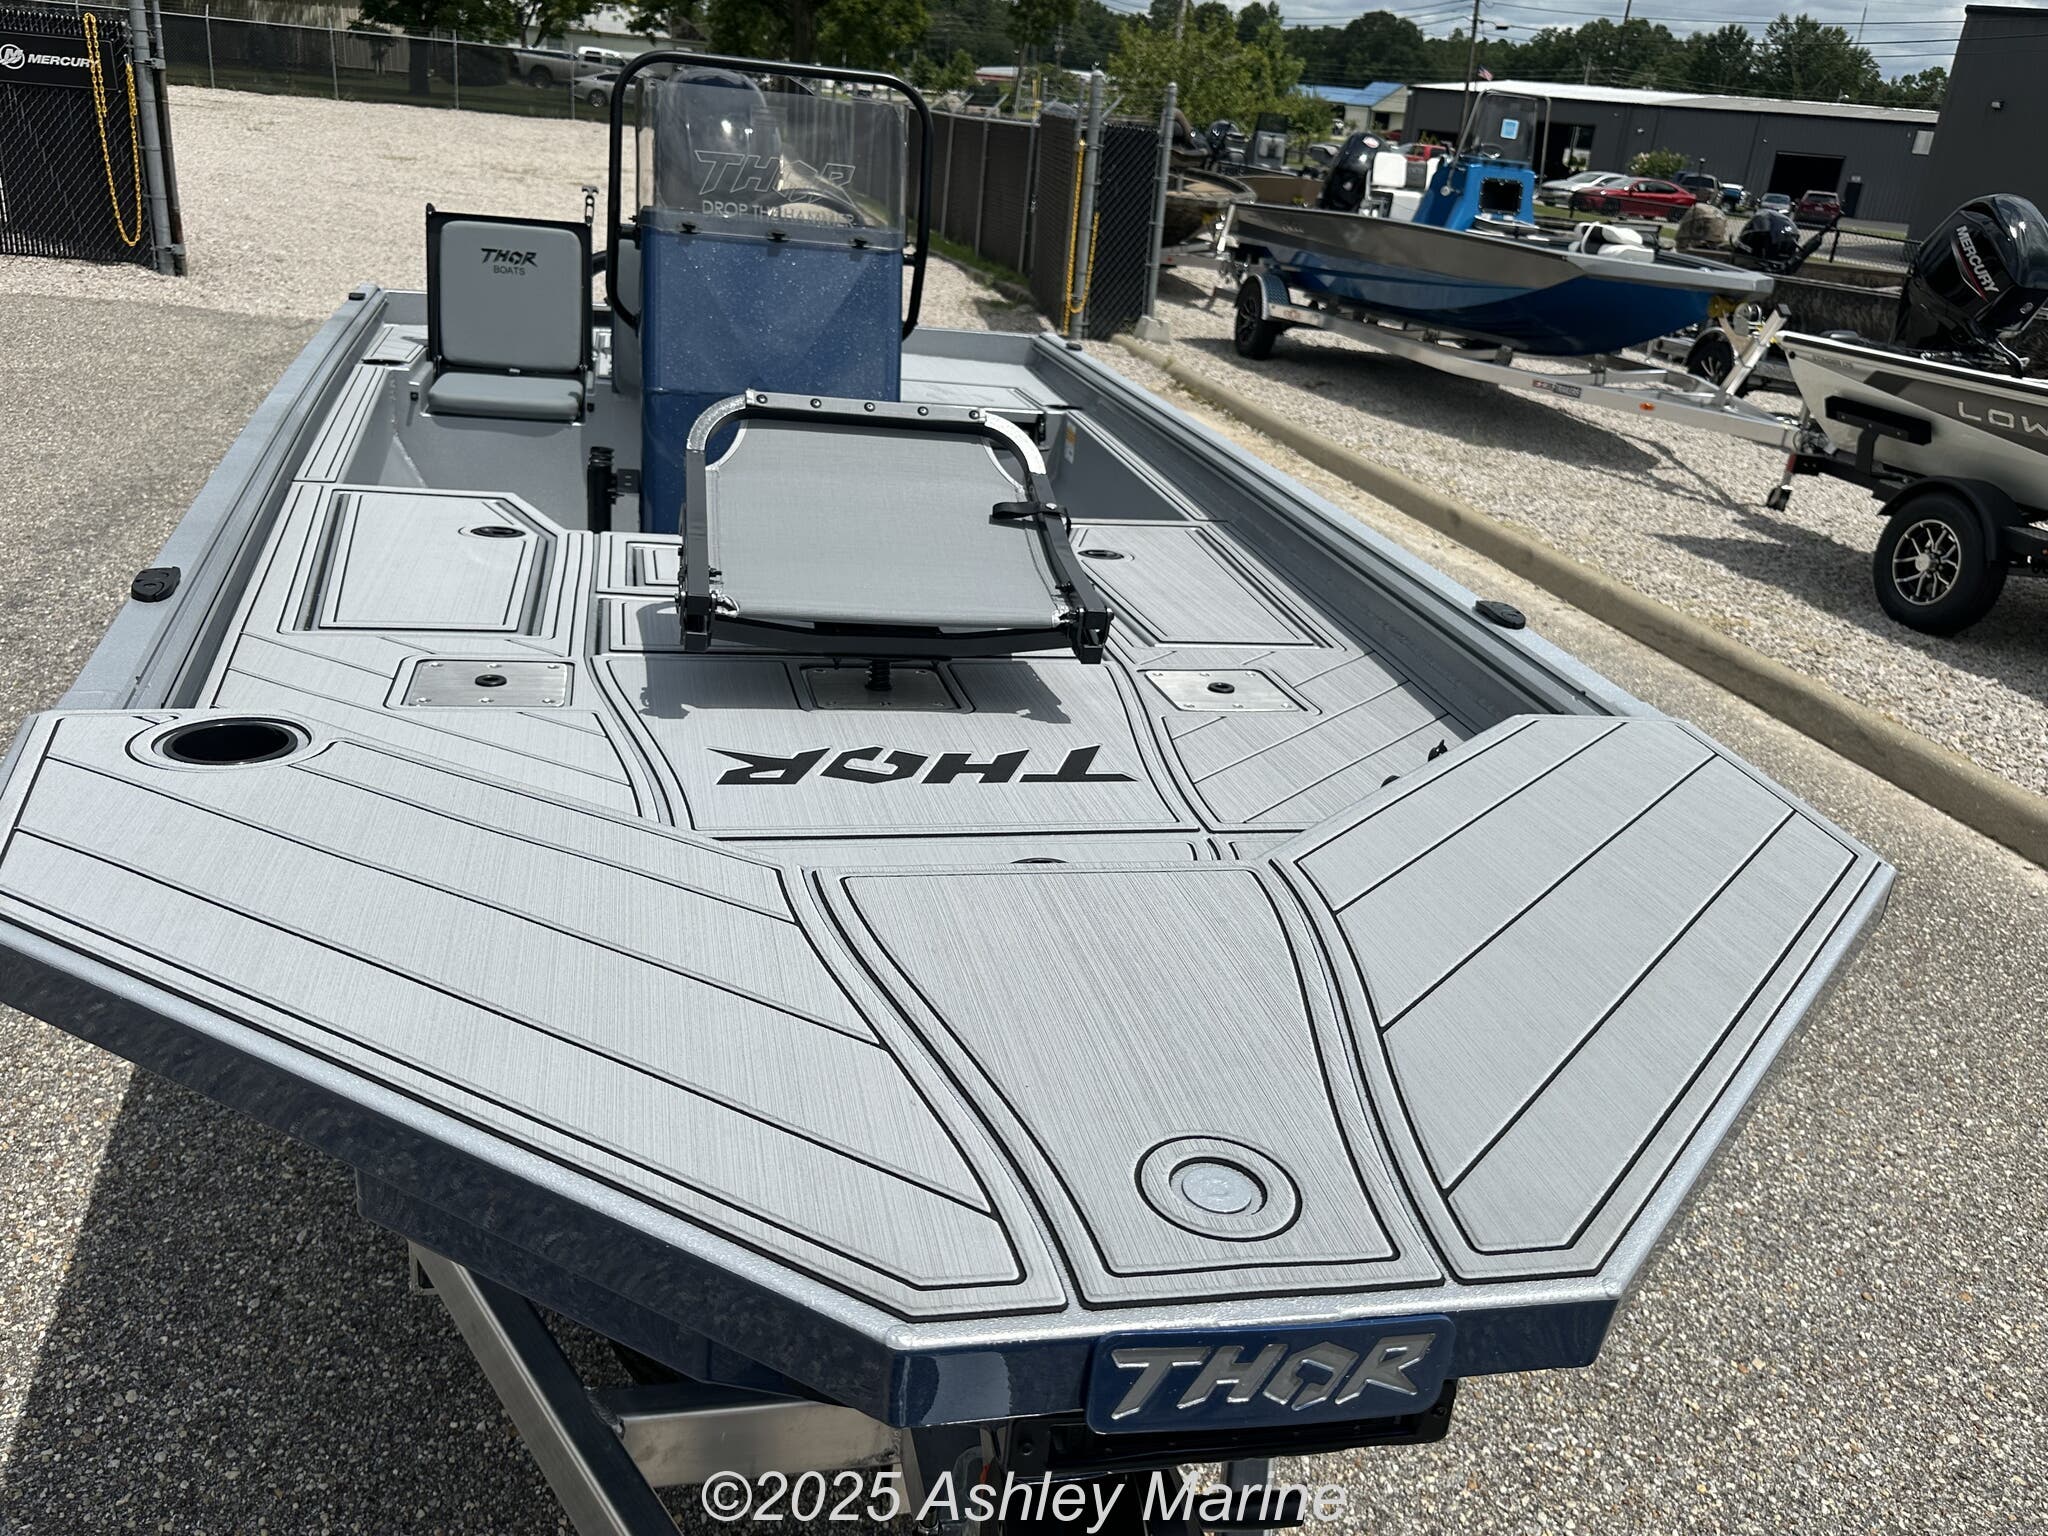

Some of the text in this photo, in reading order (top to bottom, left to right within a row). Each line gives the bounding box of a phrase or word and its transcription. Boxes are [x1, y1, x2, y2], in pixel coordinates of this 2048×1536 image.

[694, 150, 856, 208] THOR
[702, 200, 748, 217] DROP
[481, 248, 538, 267] THOR
[493, 264, 526, 276] BOATS
[1956, 225, 2000, 293] MERCURY
[1958, 401, 2048, 437] LOW
[706, 745, 1139, 784] THOR
[1111, 1333, 1436, 1420] THOR
